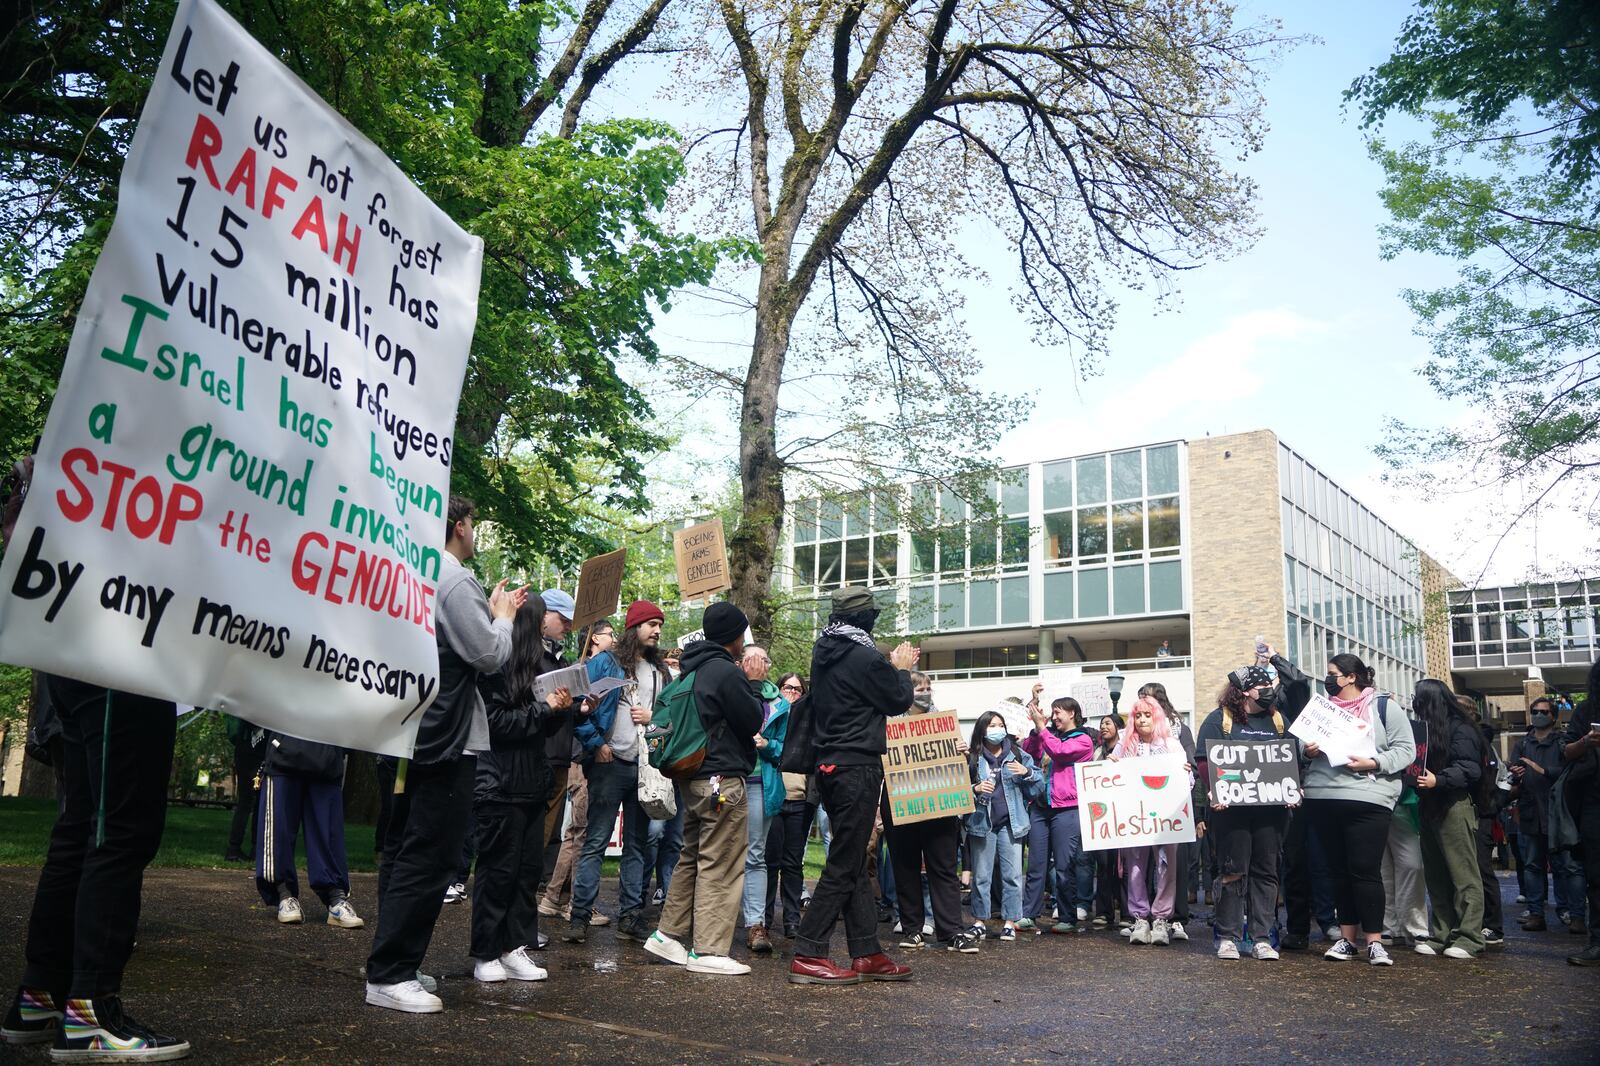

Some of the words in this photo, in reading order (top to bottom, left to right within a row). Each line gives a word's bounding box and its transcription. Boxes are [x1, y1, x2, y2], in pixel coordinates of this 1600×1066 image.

[170, 25, 240, 116] Let
[254, 115, 288, 159] us
[308, 154, 353, 201] not
[367, 192, 442, 276] forget
[185, 113, 362, 276] RAFAH
[388, 265, 439, 331] has
[166, 176, 248, 269] 1.5
[285, 262, 417, 386] million
[101, 294, 246, 411] Israel
[279, 376, 333, 449] has
[369, 431, 442, 519] begun
[356, 376, 452, 467] refugees
[89, 403, 117, 445] a
[167, 423, 314, 516] ground
[330, 485, 441, 582] invasion
[57, 448, 203, 545] STOP
[219, 510, 271, 563] the
[291, 531, 435, 637] GENOCIDE
[683, 532, 715, 550] BOEING
[692, 548, 710, 561] ARMS
[687, 559, 722, 581] GENOCIDE
[12, 526, 85, 623] by
[100, 575, 175, 648] any
[191, 597, 290, 659] means
[303, 634, 436, 726] necessary
[1313, 696, 1336, 713] FROM
[1339, 711, 1354, 723] THE
[886, 721, 907, 740] ROM
[909, 716, 955, 738] PORTLAND
[1301, 715, 1312, 726] TO
[1317, 726, 1332, 738] THE
[887, 746, 901, 766] TO
[904, 738, 961, 765] PALESTINE
[1210, 744, 1249, 765] CUT
[1253, 743, 1293, 763] TIES
[889, 763, 964, 797] SOLIDARITY
[1082, 763, 1126, 792] Free
[1215, 777, 1301, 805] BOEING
[895, 800, 905, 817] IS
[907, 796, 925, 816] NOT
[928, 799, 935, 812] A
[938, 789, 970, 811] CRIME!
[1088, 800, 1183, 840] Palestine
